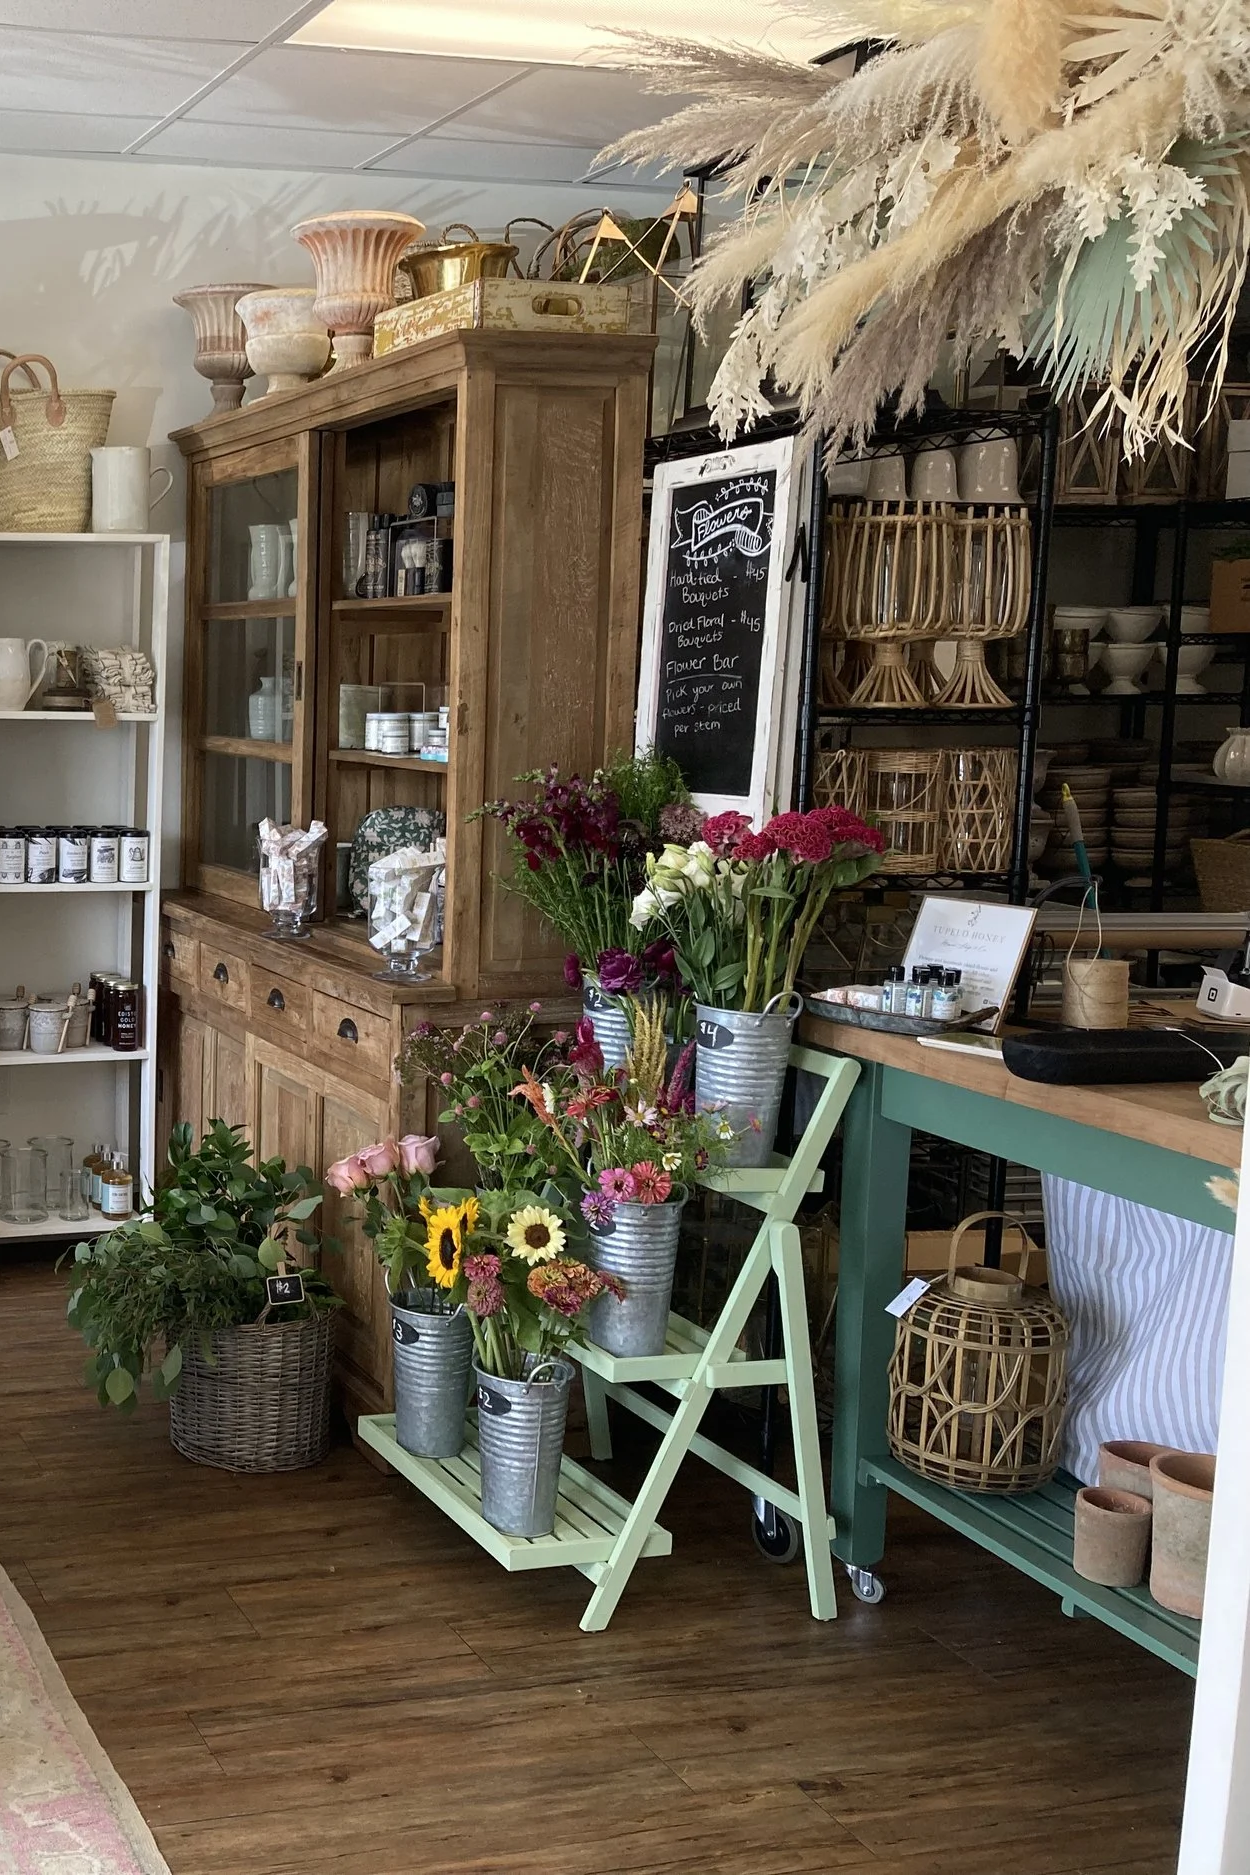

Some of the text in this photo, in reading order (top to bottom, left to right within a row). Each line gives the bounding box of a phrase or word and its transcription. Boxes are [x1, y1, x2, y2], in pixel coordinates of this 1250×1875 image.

[697, 505, 753, 541] Flowers
[669, 567, 723, 588] Hand-tied
[668, 617, 696, 633] Dried
[697, 613, 725, 630] Floral
[677, 630, 724, 648] Bouquets
[666, 653, 740, 678] Flower Bar
[665, 680, 743, 703] Pick your own
[661, 703, 697, 719] flowers
[707, 697, 742, 714] priced
[674, 721, 721, 738] per stem
[933, 925, 1006, 943] TUPELO HONEY
[700, 1021, 719, 1047] $4
